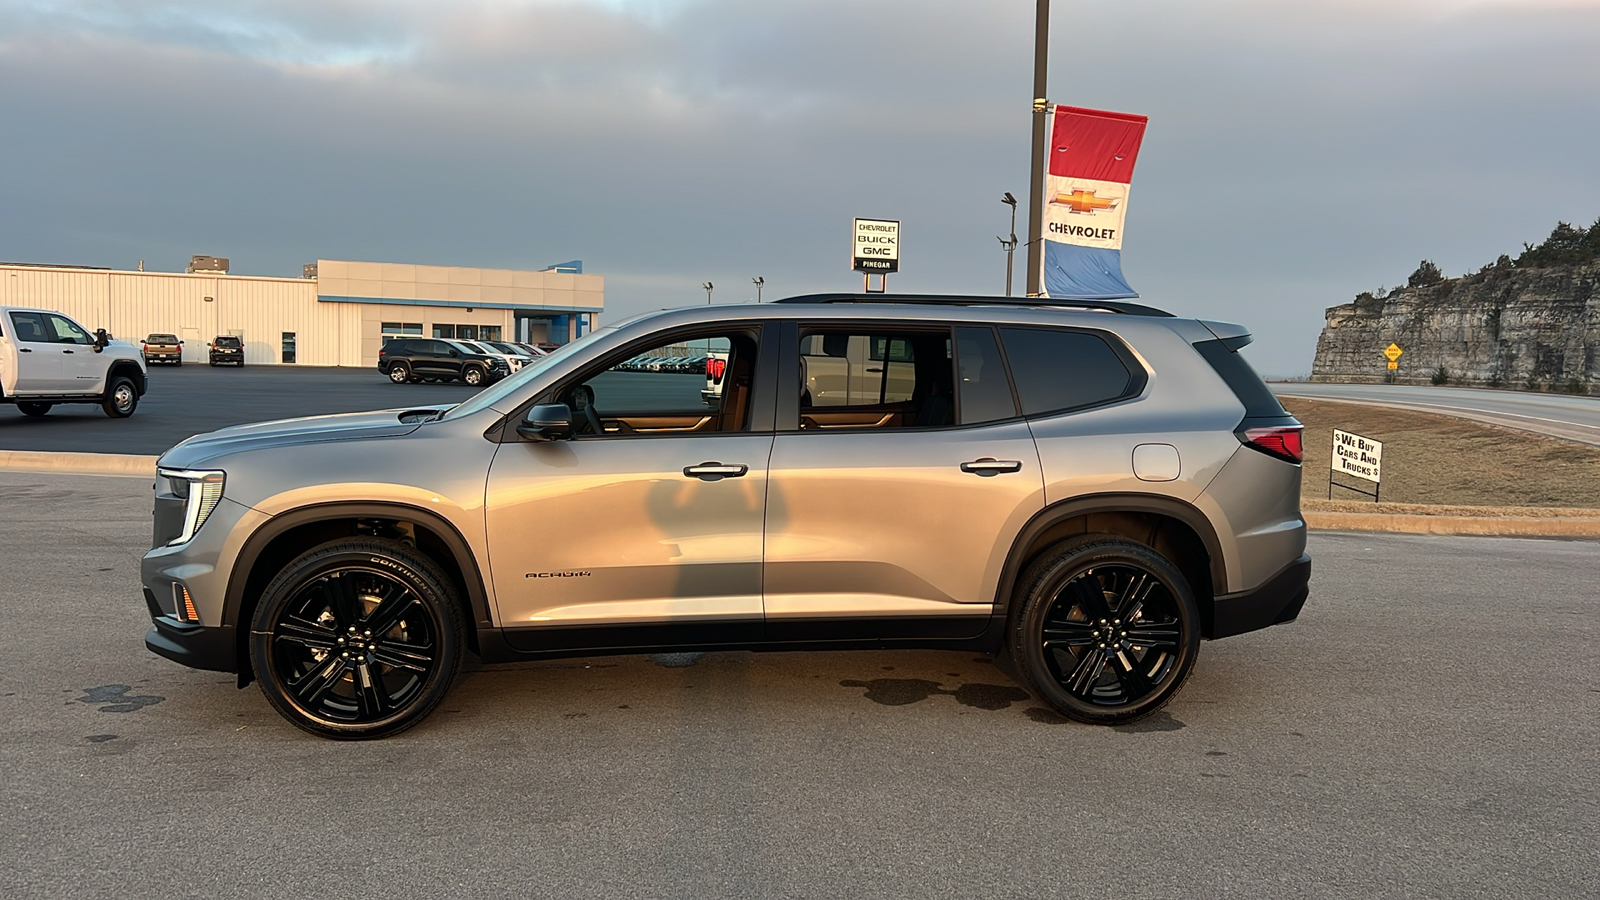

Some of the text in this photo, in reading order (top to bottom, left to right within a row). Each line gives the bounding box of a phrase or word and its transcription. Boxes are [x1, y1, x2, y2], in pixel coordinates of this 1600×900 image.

[859, 223, 896, 233] CHEVROLET
[1049, 222, 1115, 240] CHEVROLET
[857, 235, 896, 244] BUICK
[862, 247, 891, 256] GMC
[862, 260, 891, 269] PINEGAR
[370, 556, 439, 604] CONTINENTA
